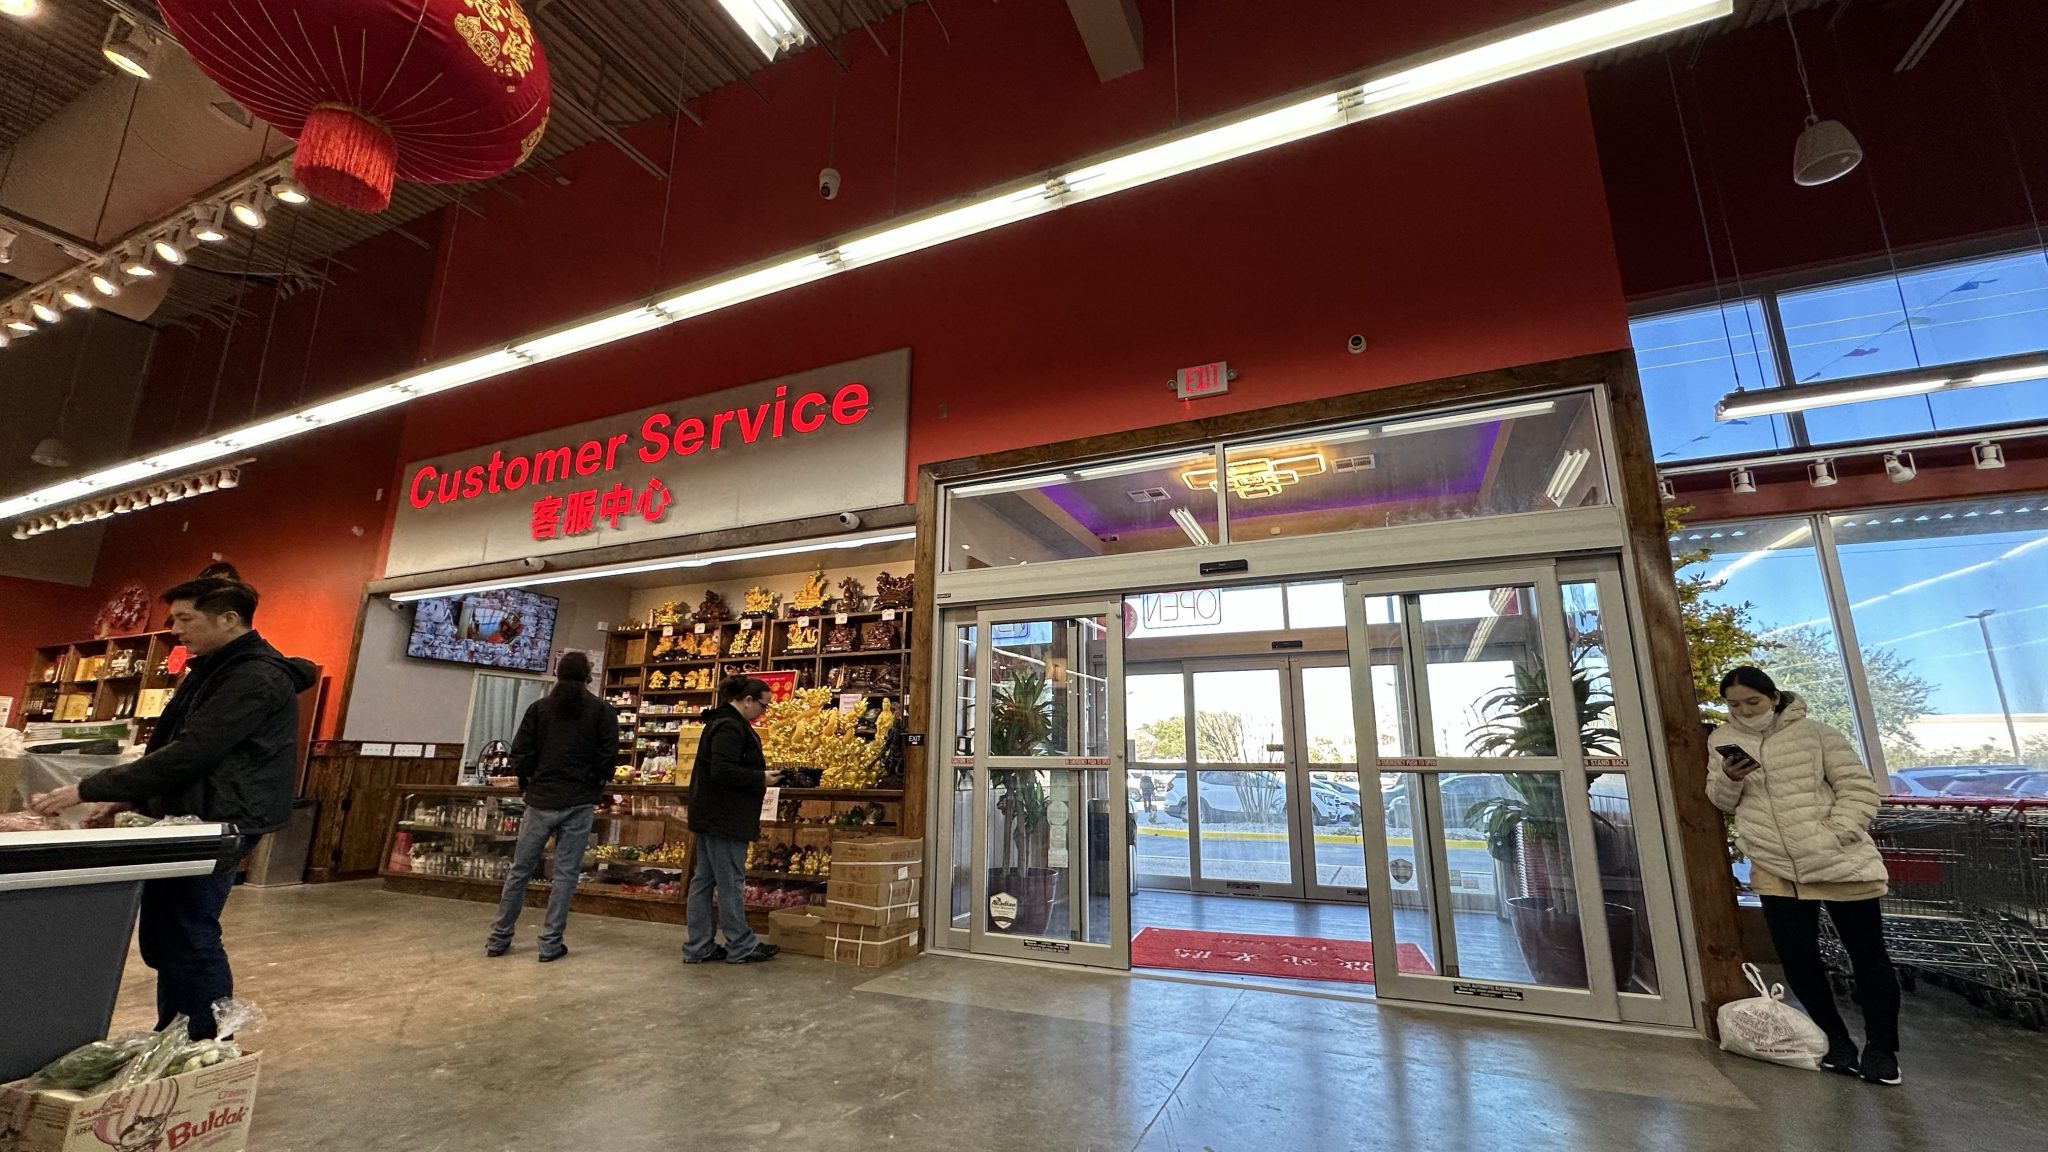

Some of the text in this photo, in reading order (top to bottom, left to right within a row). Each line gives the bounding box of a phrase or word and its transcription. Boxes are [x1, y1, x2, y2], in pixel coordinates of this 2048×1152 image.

[1185, 364, 1219, 393] EXIT
[409, 383, 870, 509] Customer Service
[529, 477, 672, 542] 客服中心
[166, 1106, 246, 1150] Buldak
